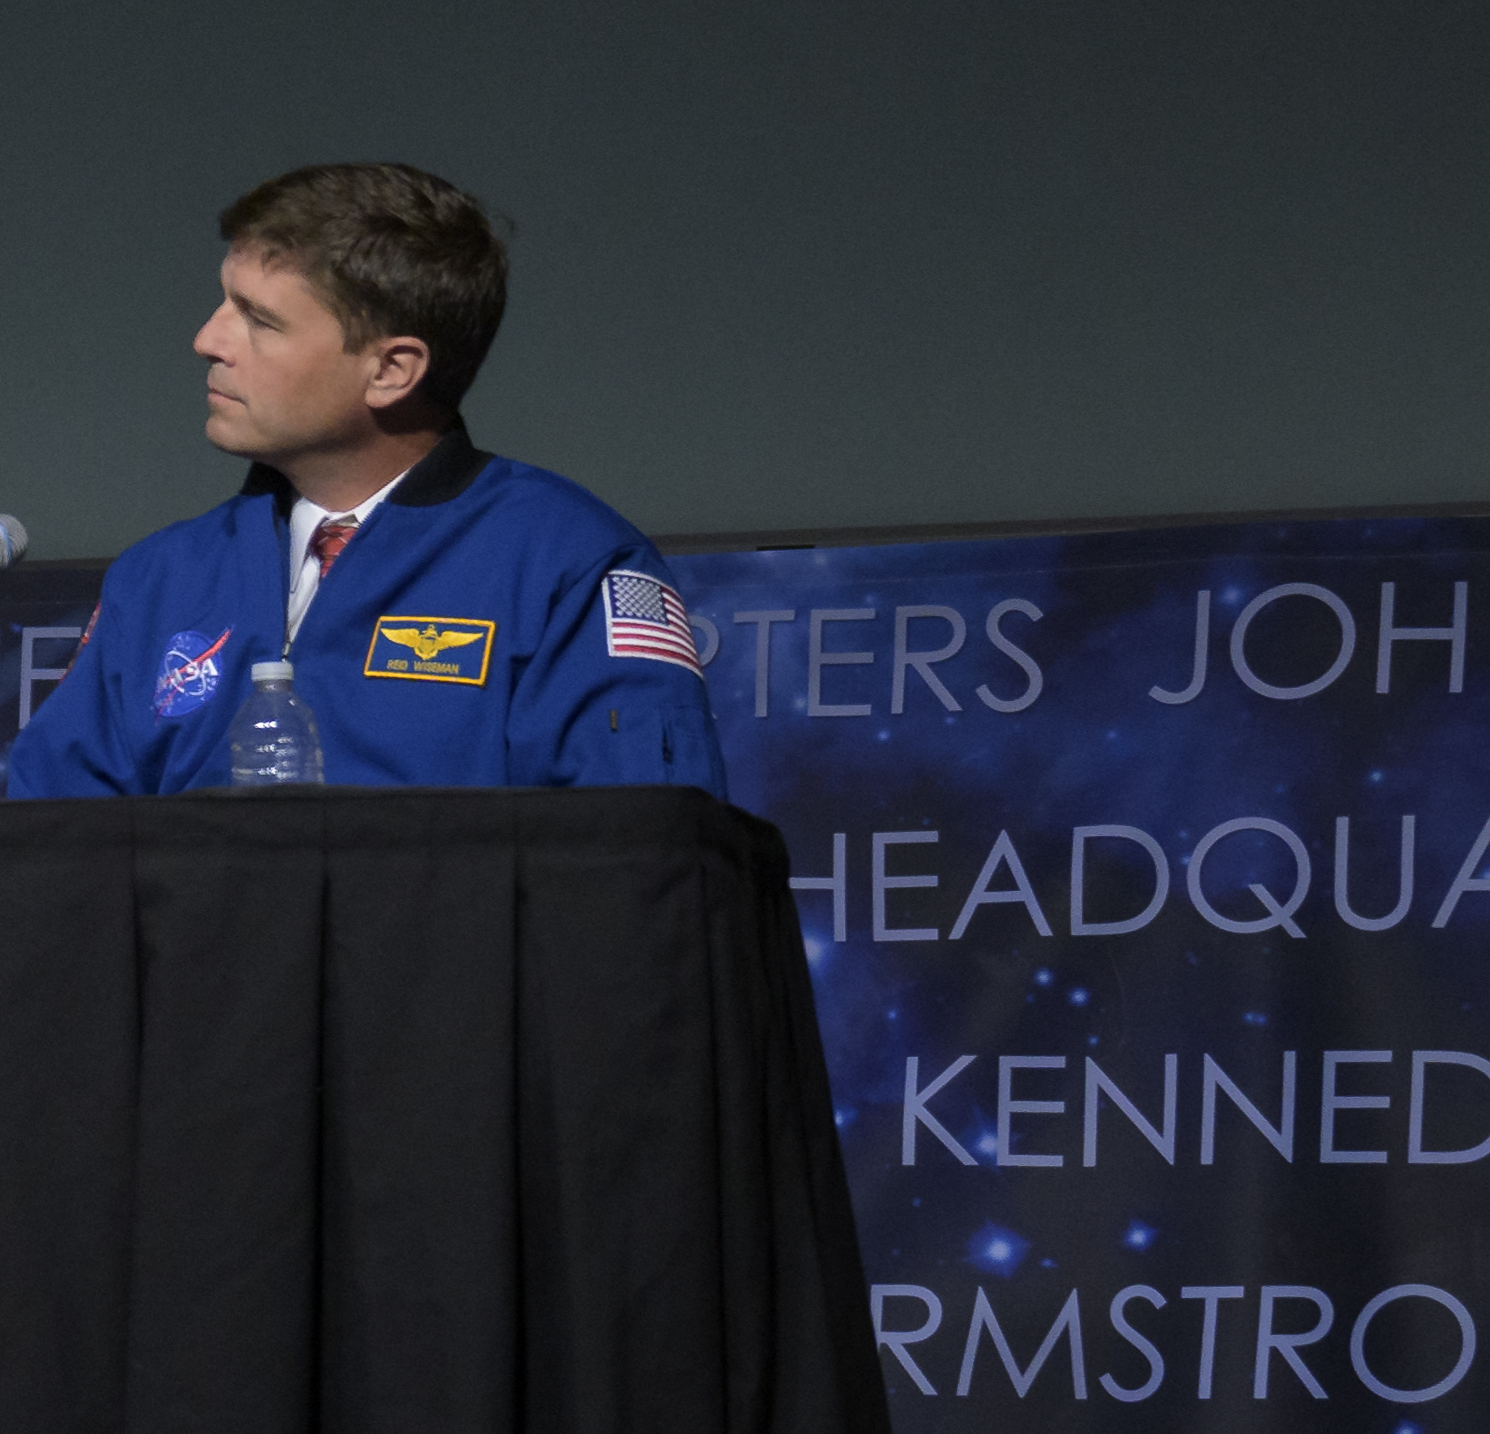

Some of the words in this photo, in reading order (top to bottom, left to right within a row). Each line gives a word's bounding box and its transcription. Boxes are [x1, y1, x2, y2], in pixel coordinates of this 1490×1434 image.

[1147, 580, 1470, 706] JOH
[900, 1049, 1490, 1168] KENNED
[869, 1282, 1478, 1404] RMSTRO
